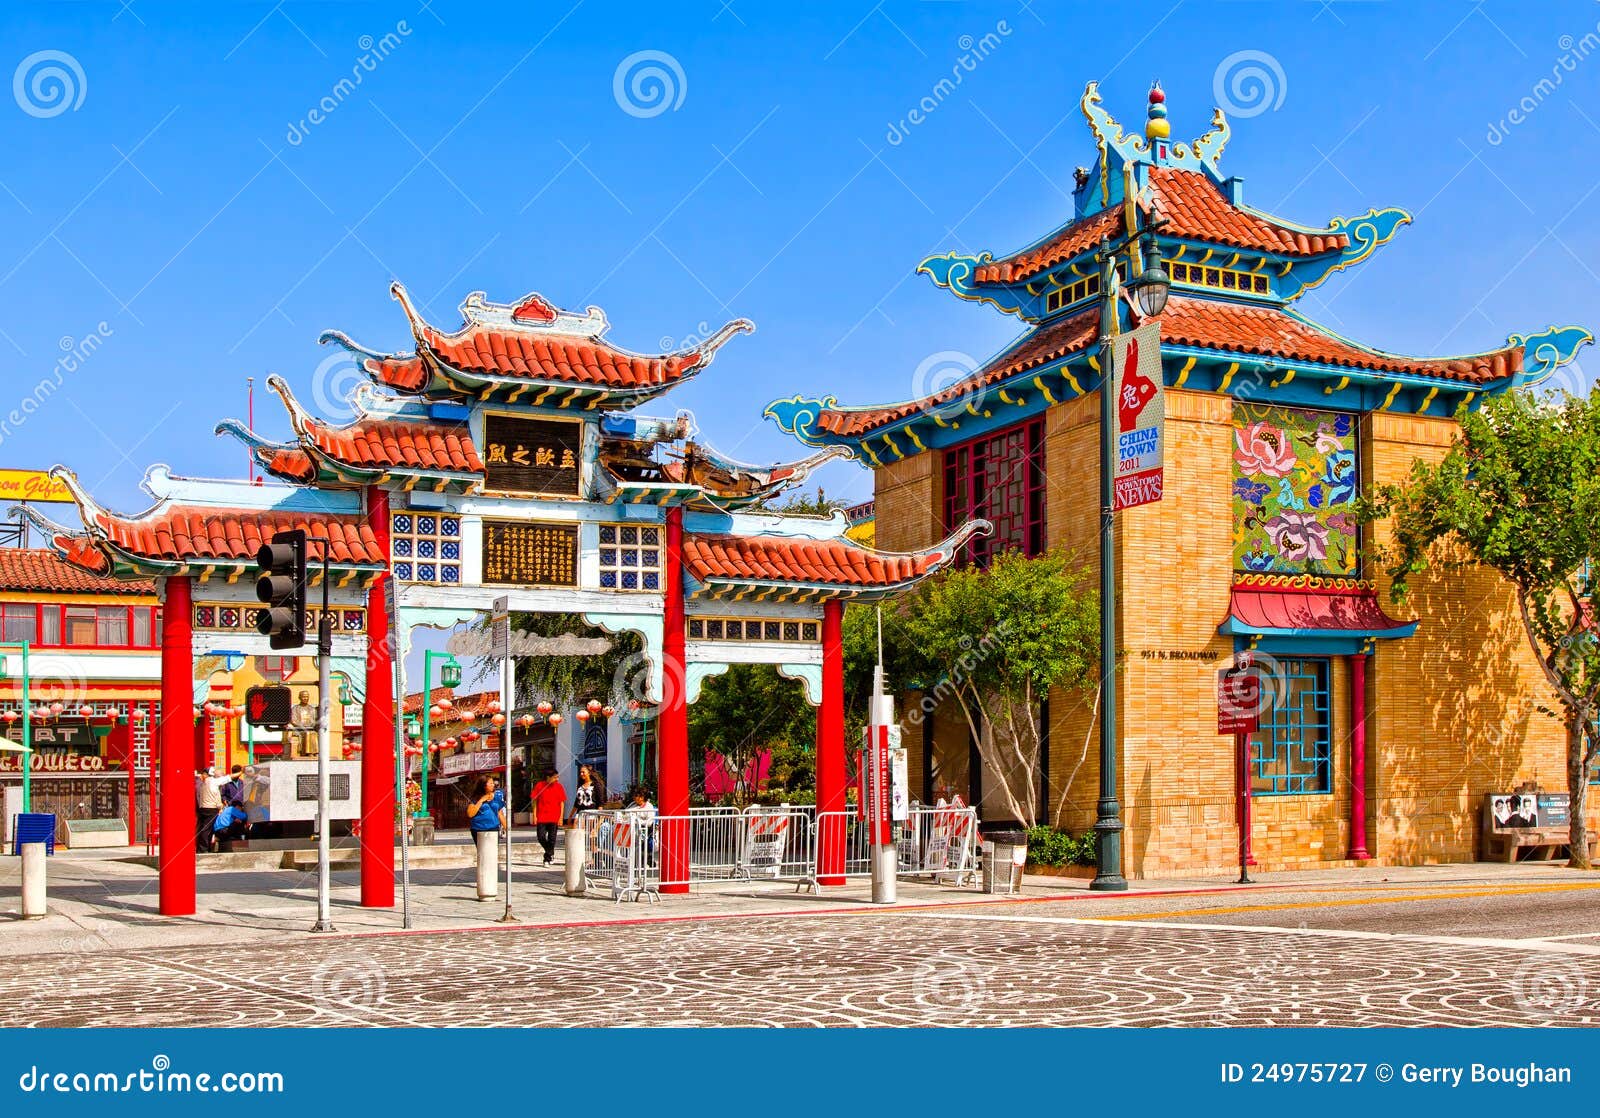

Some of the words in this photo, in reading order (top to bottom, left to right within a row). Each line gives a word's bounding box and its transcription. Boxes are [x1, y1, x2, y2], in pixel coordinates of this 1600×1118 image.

[1121, 384, 1140, 410] 兔
[1119, 427, 1159, 446] CHINA
[1119, 440, 1157, 460] TOWN
[1119, 457, 1140, 472] 2011
[0, 480, 20, 490] on
[1116, 474, 1162, 491] DOWNTOWN
[1115, 483, 1162, 508] NEWS
[1140, 650, 1156, 660] 951
[1169, 650, 1219, 660] BROADWAY
